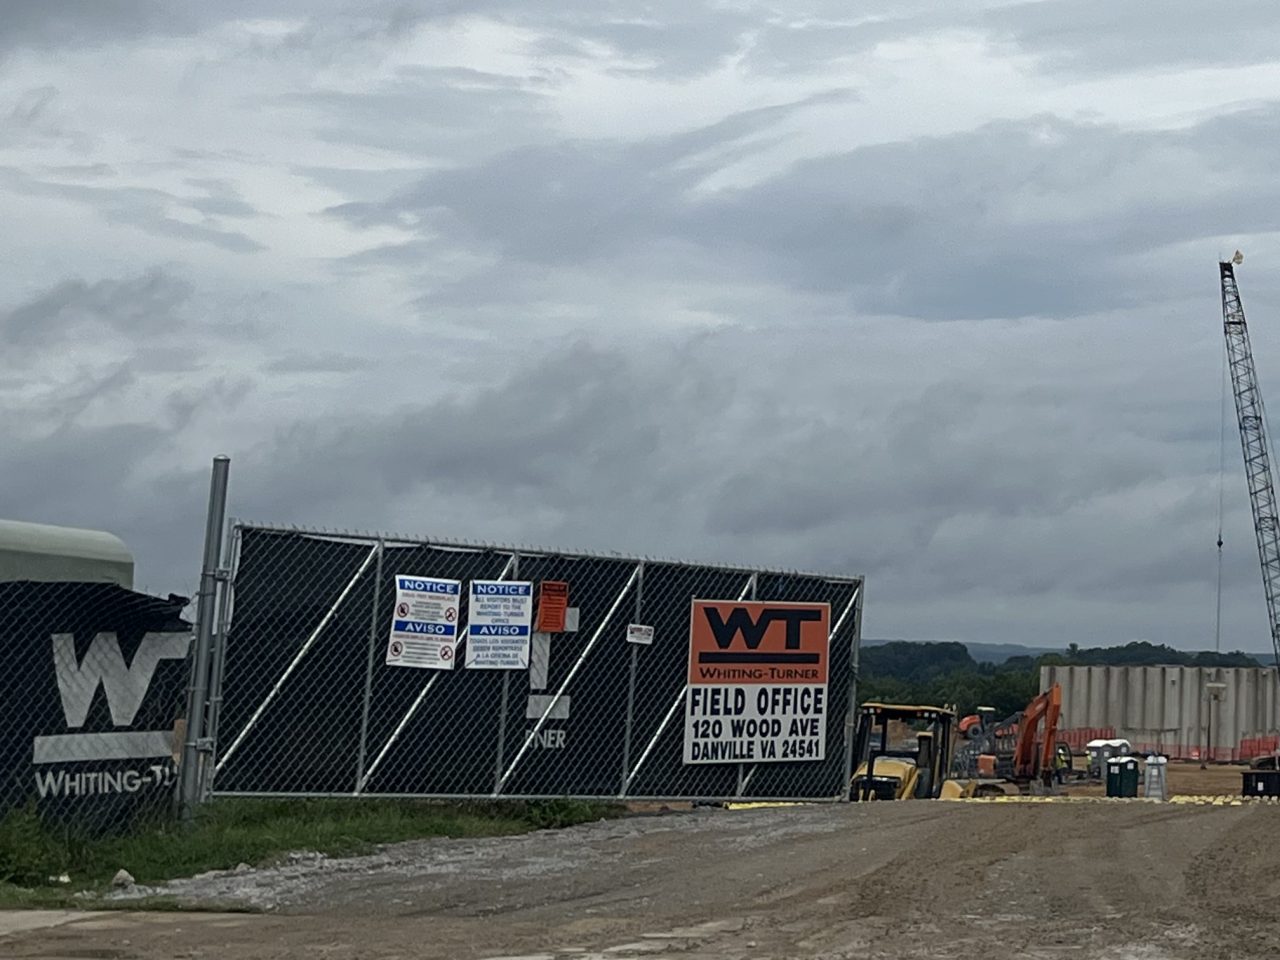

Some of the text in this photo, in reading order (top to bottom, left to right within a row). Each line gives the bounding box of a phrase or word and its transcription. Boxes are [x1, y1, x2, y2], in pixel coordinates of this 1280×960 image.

[404, 580, 455, 593] NOTICE
[477, 585, 527, 594] NOTICE
[405, 622, 445, 634] AVISO
[480, 626, 520, 635] AVISO
[703, 607, 822, 649] WT
[699, 667, 819, 680] WHITING-TURNER
[690, 687, 824, 716] FIELD OFFICE
[692, 718, 820, 739] 120 WOOD AVE
[691, 739, 820, 761] DANVILLE VA 24541
[34, 765, 178, 797] WHITING-TU
